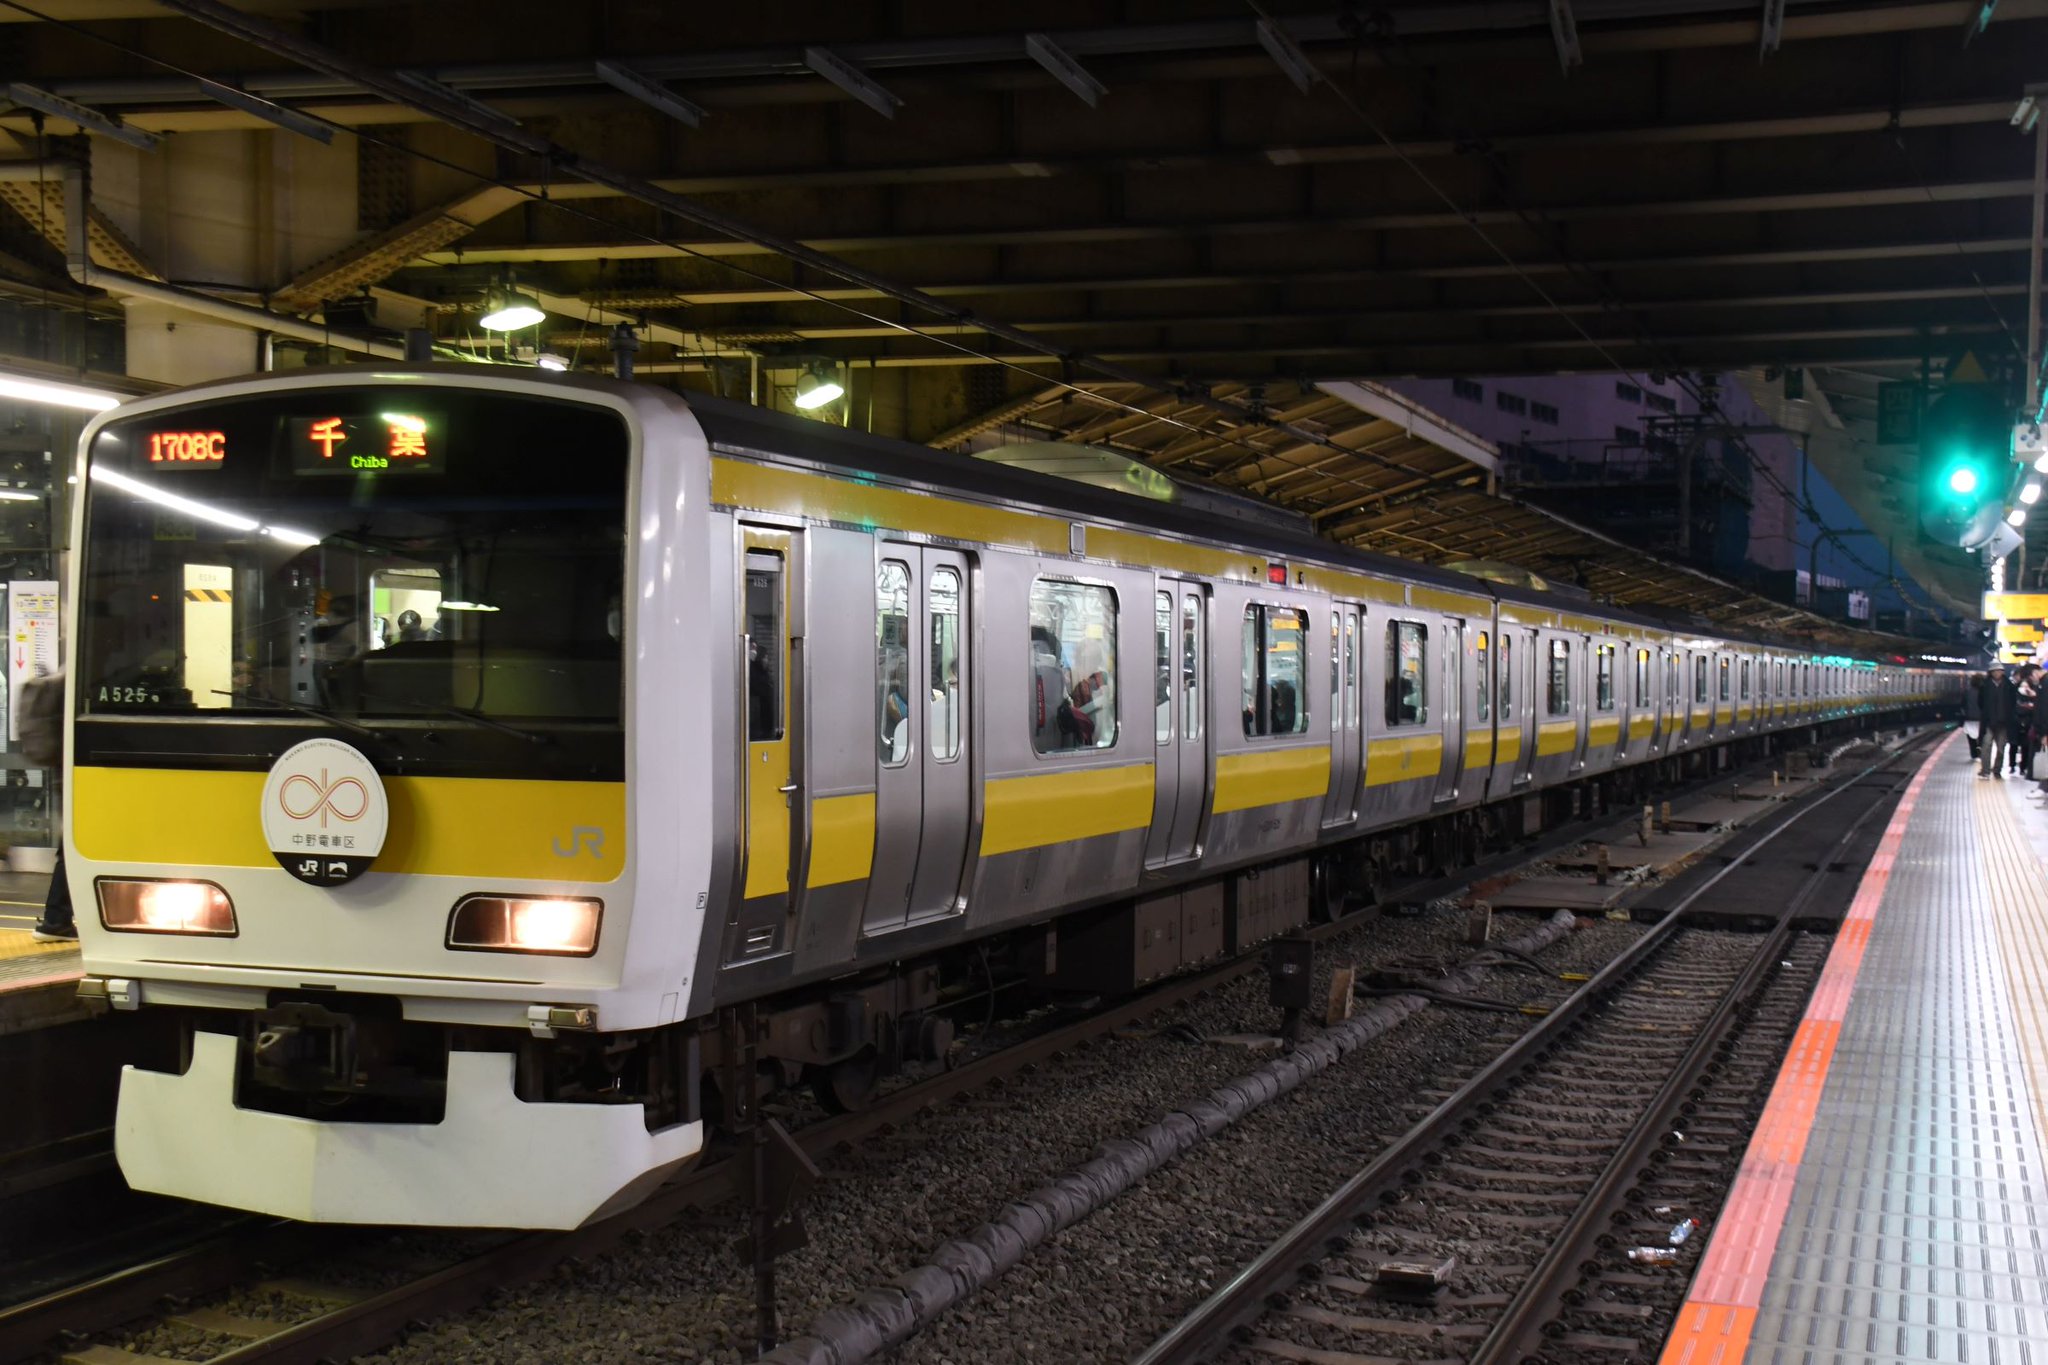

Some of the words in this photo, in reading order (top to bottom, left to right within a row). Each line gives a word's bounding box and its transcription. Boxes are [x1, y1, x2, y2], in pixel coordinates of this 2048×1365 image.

[310, 416, 427, 457] 千葉
[150, 433, 225, 461] 1708C
[351, 456, 388, 468] Chiba
[100, 687, 145, 702] A525
[292, 833, 355, 848] 中野電車区
[552, 826, 605, 859] JR
[299, 860, 318, 873] JR
